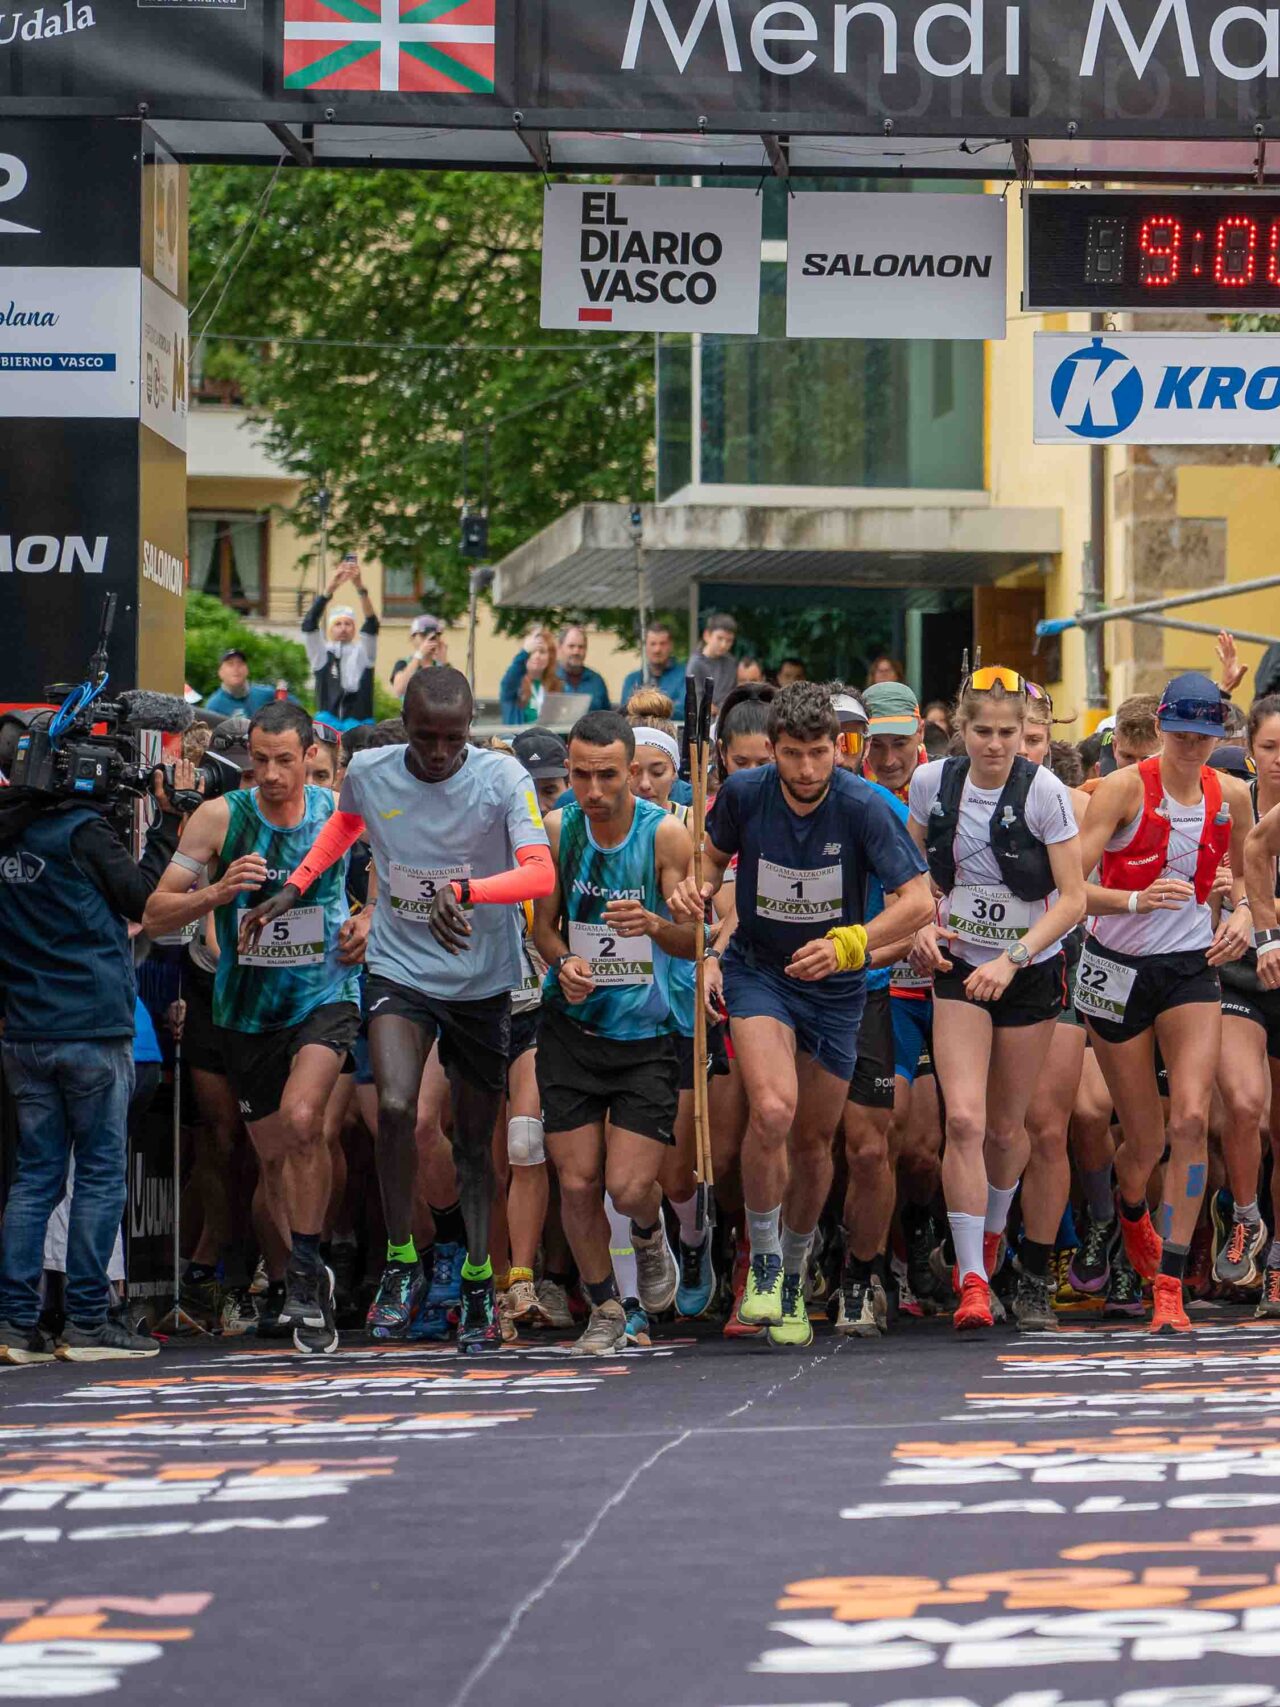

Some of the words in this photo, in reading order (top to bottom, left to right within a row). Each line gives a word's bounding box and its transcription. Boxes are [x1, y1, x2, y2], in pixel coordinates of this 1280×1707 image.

[581, 192, 628, 225] EL
[580, 229, 723, 266] DIARIO
[802, 253, 992, 278] SALOMON
[581, 269, 717, 305] VASCO
[59, 356, 104, 368] VASCO
[143, 540, 183, 597] SALOMON
[96, 763, 102, 776] 8
[420, 880, 437, 899] 3
[790, 881, 804, 899] 1
[765, 898, 833, 915] ZEGAMA
[971, 898, 1006, 923] 30
[272, 921, 290, 941] 5
[955, 917, 1020, 940] ZEGAMA
[598, 937, 617, 957] 2
[590, 963, 643, 975] EGAMA
[1080, 963, 1108, 992] 22
[1221, 1003, 1252, 1014] ERREX
